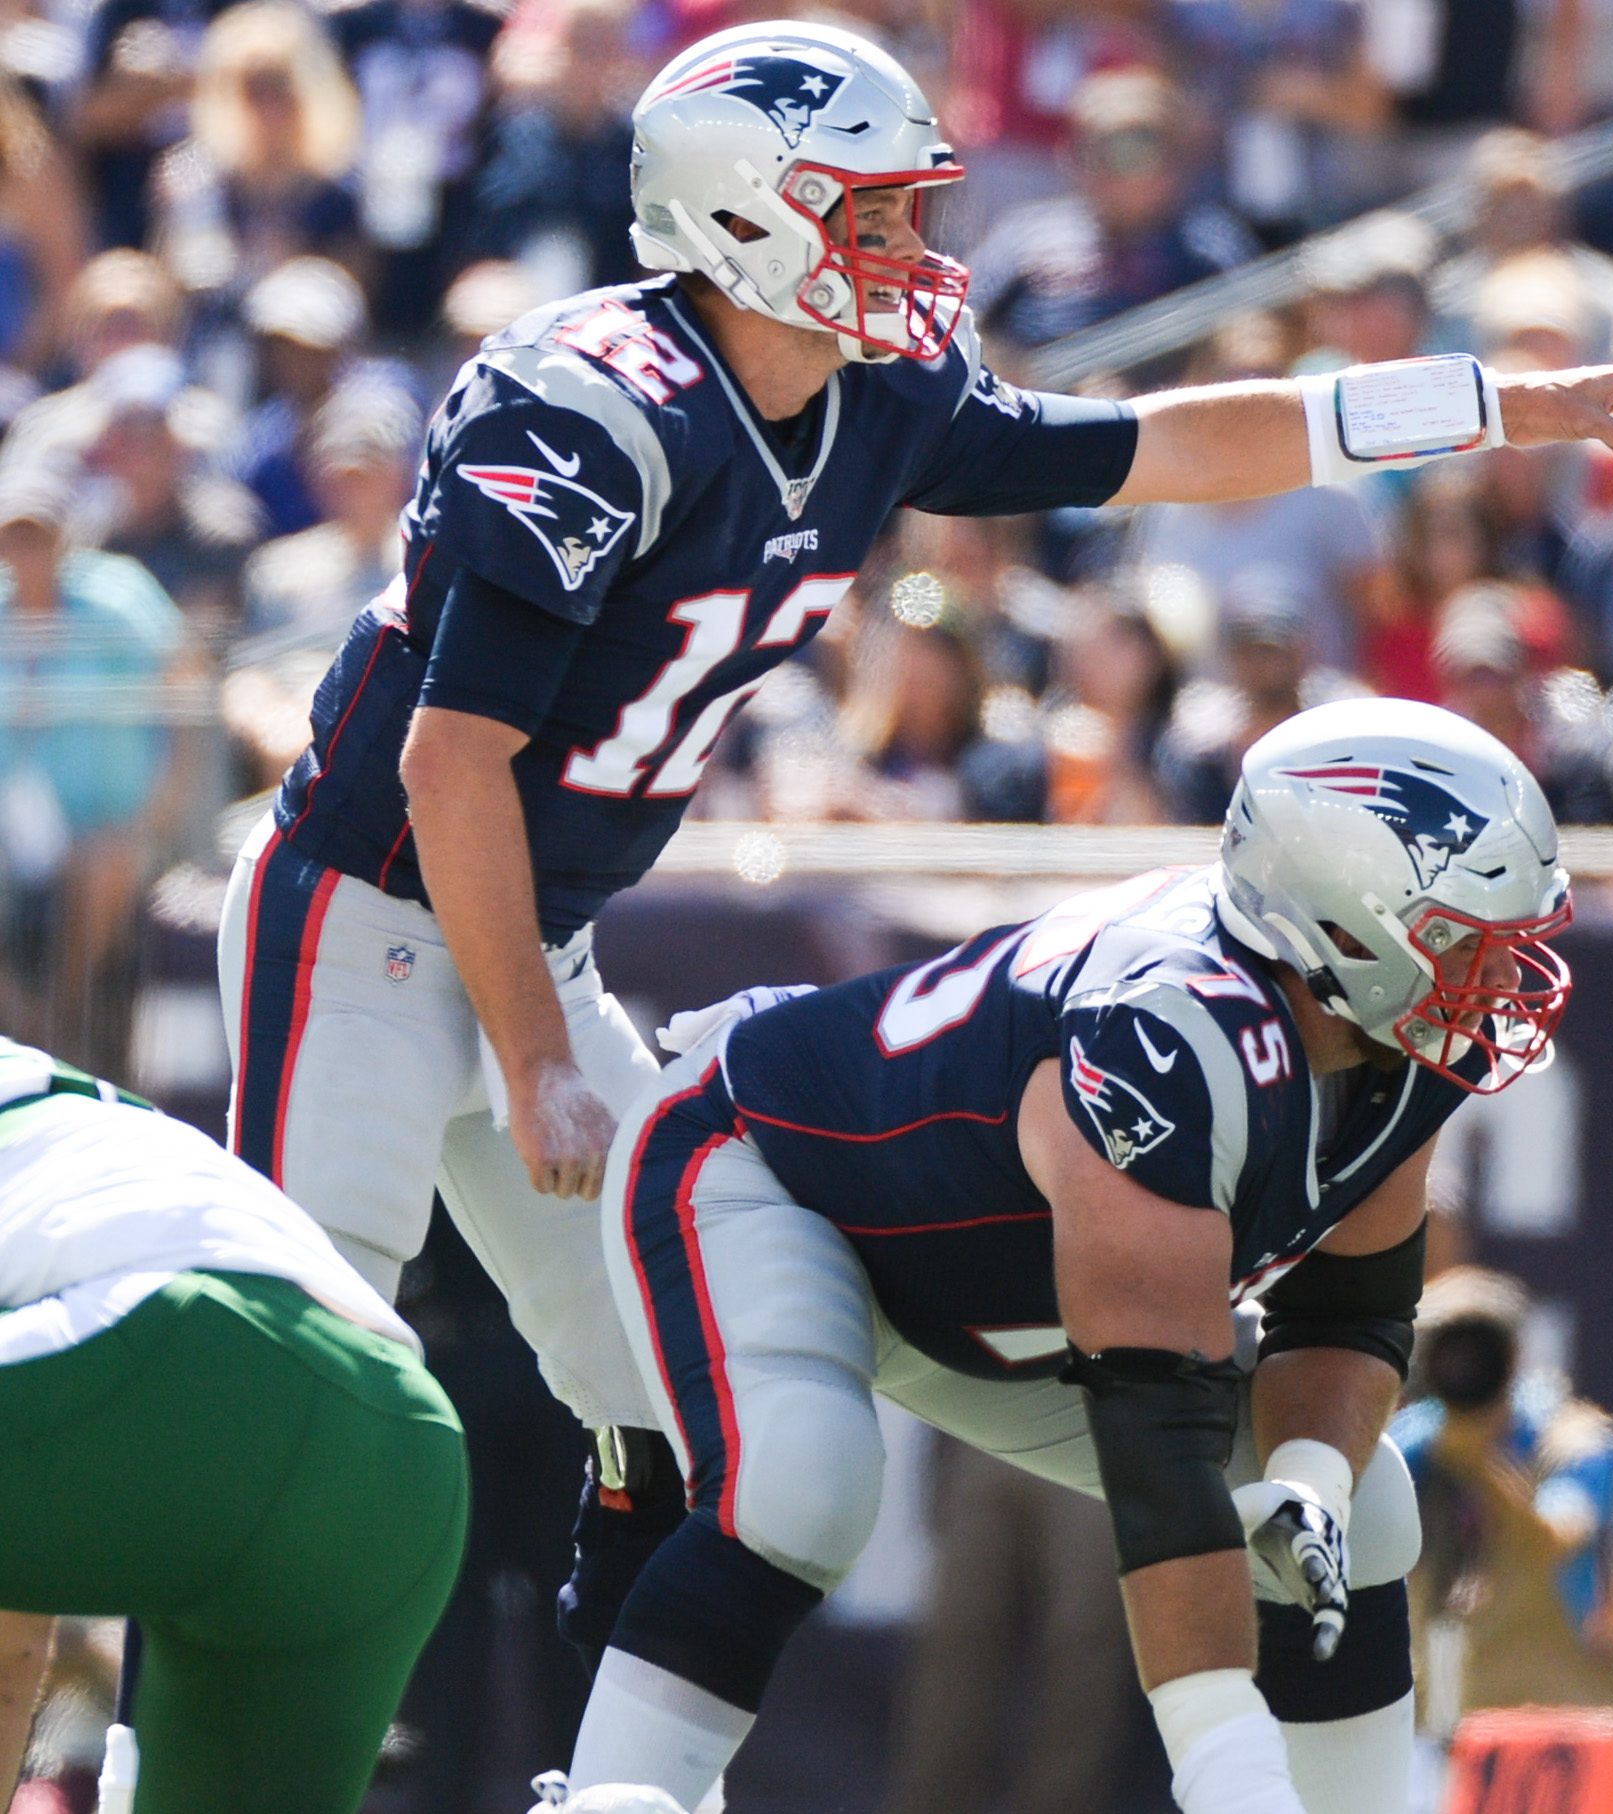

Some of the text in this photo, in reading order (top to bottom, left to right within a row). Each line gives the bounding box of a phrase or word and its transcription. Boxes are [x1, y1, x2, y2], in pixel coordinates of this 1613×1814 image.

[554, 299, 705, 405] 12
[763, 528, 819, 564] PATRIOTS
[1184, 957, 1293, 1087] 75
